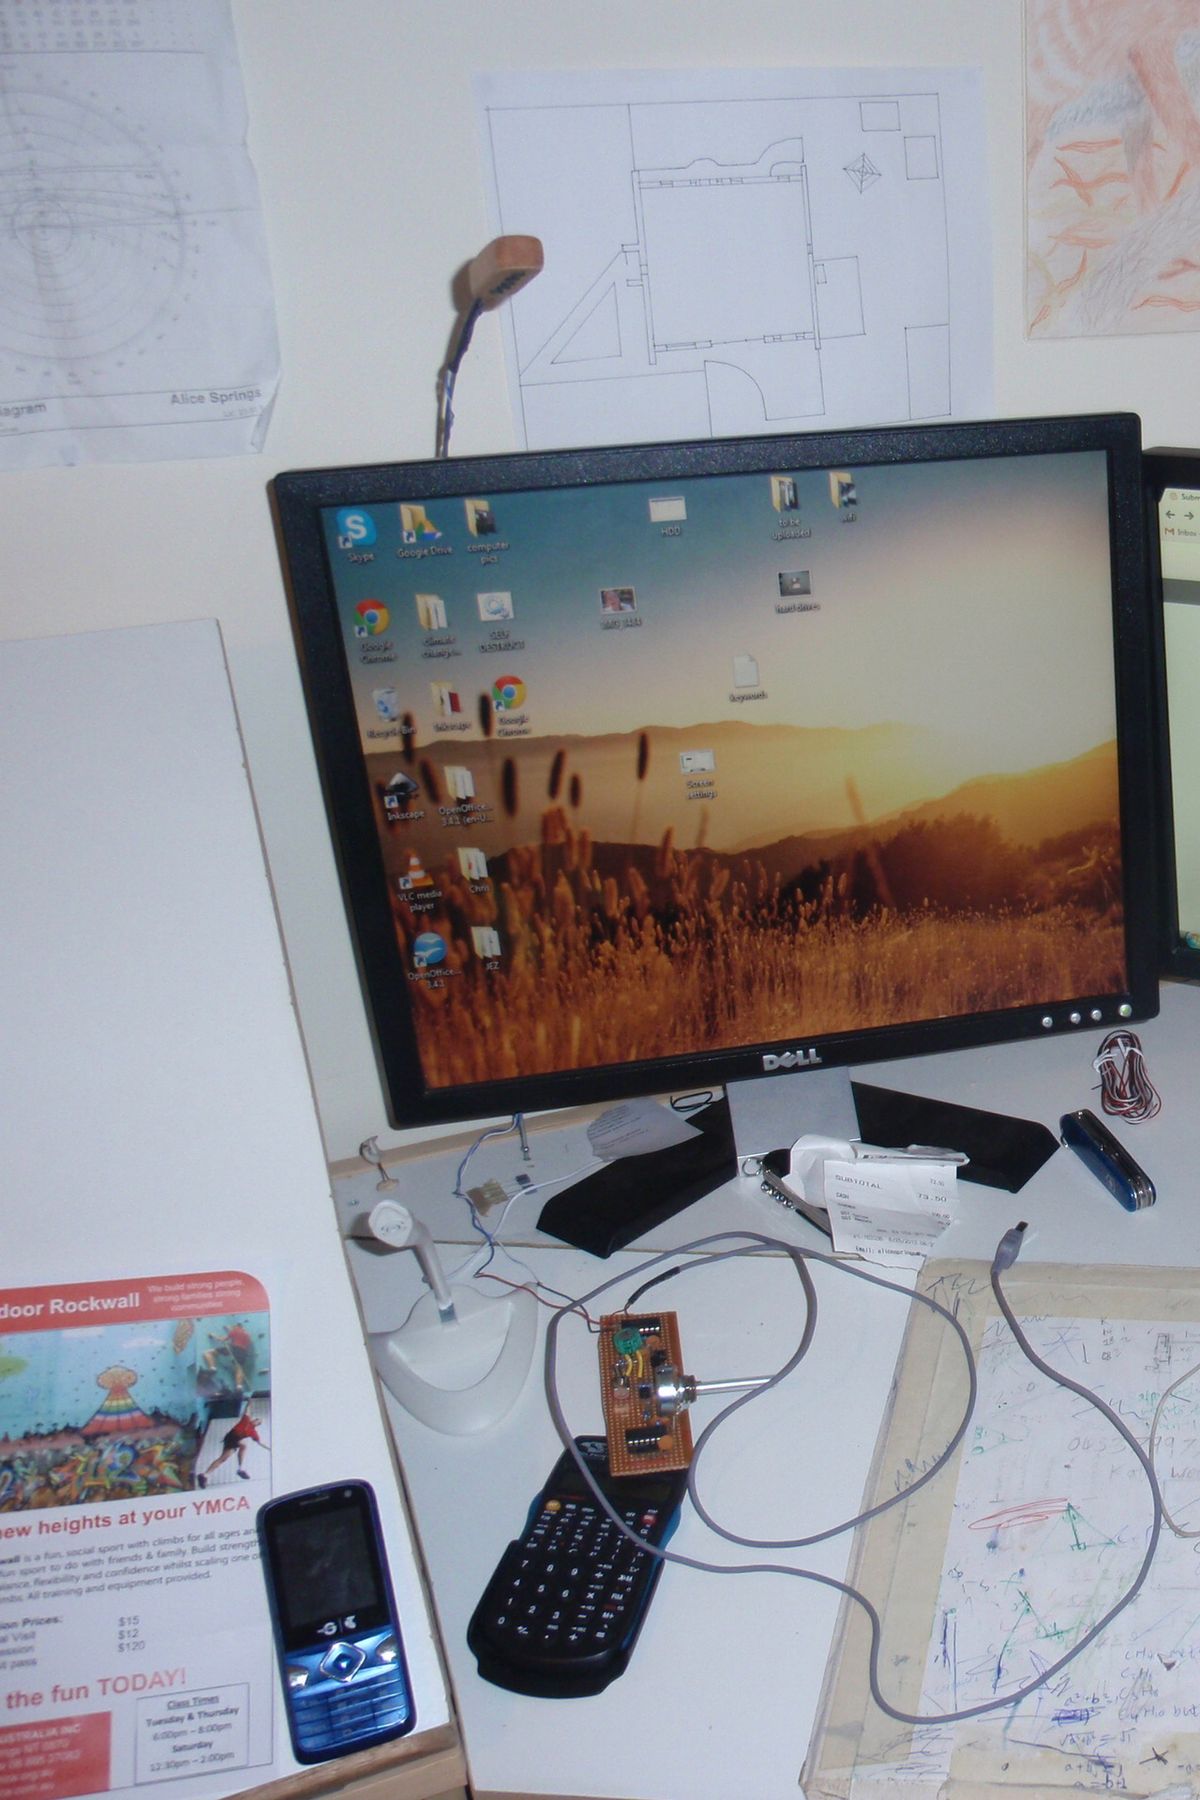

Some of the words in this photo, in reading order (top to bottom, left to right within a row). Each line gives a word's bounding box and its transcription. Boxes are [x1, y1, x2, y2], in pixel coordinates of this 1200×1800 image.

[170, 392, 206, 405] Alice
[209, 388, 262, 404] Springs
[762, 1048, 823, 1072] DELL
[50, 1293, 141, 1315] Rockwall
[0, 1524, 32, 1540] ew
[38, 1515, 112, 1535] heights
[119, 1511, 137, 1526] at
[142, 1505, 187, 1524] your
[192, 1496, 250, 1516] YMCA
[521, 1559, 529, 1568] 7
[117, 1615, 141, 1628] $15
[117, 1628, 140, 1641] $12
[6, 1690, 43, 1710] the
[51, 1683, 90, 1704] fun
[96, 1667, 187, 1697] TODAY!
